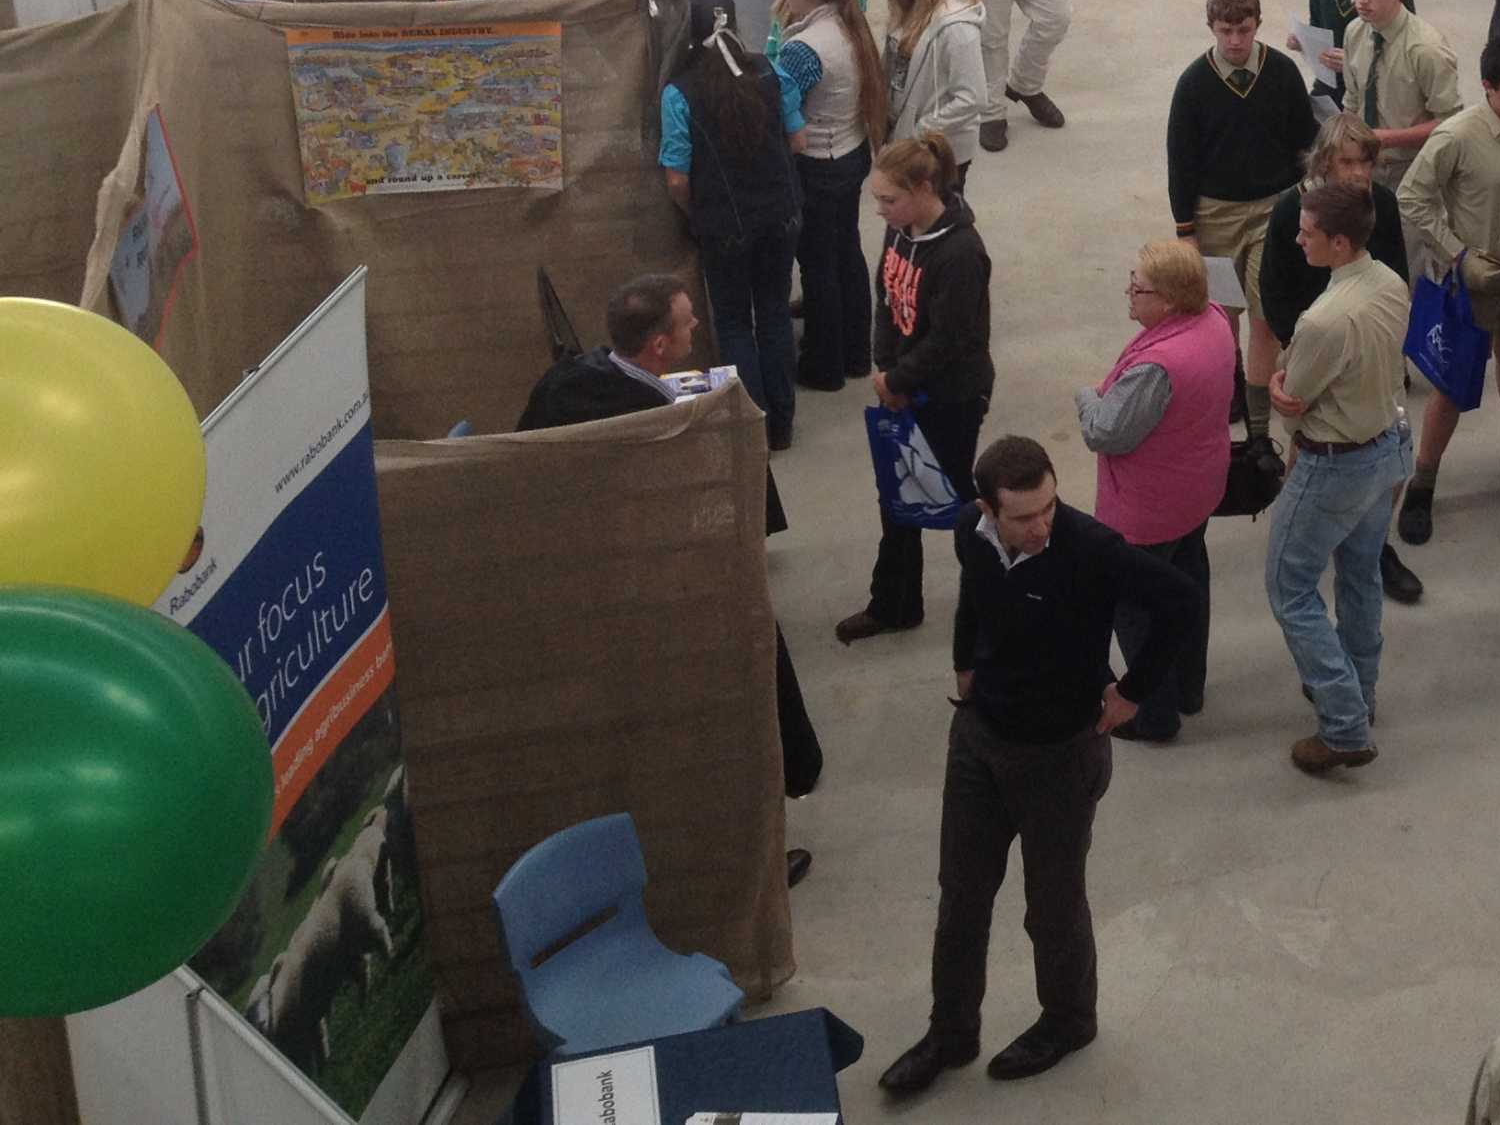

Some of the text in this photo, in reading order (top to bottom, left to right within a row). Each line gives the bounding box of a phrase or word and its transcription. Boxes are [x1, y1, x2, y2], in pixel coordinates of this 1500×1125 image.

[387, 176, 417, 184] round
[421, 175, 434, 183] up
[169, 557, 218, 616] Rabobank
[257, 551, 328, 654] focus
